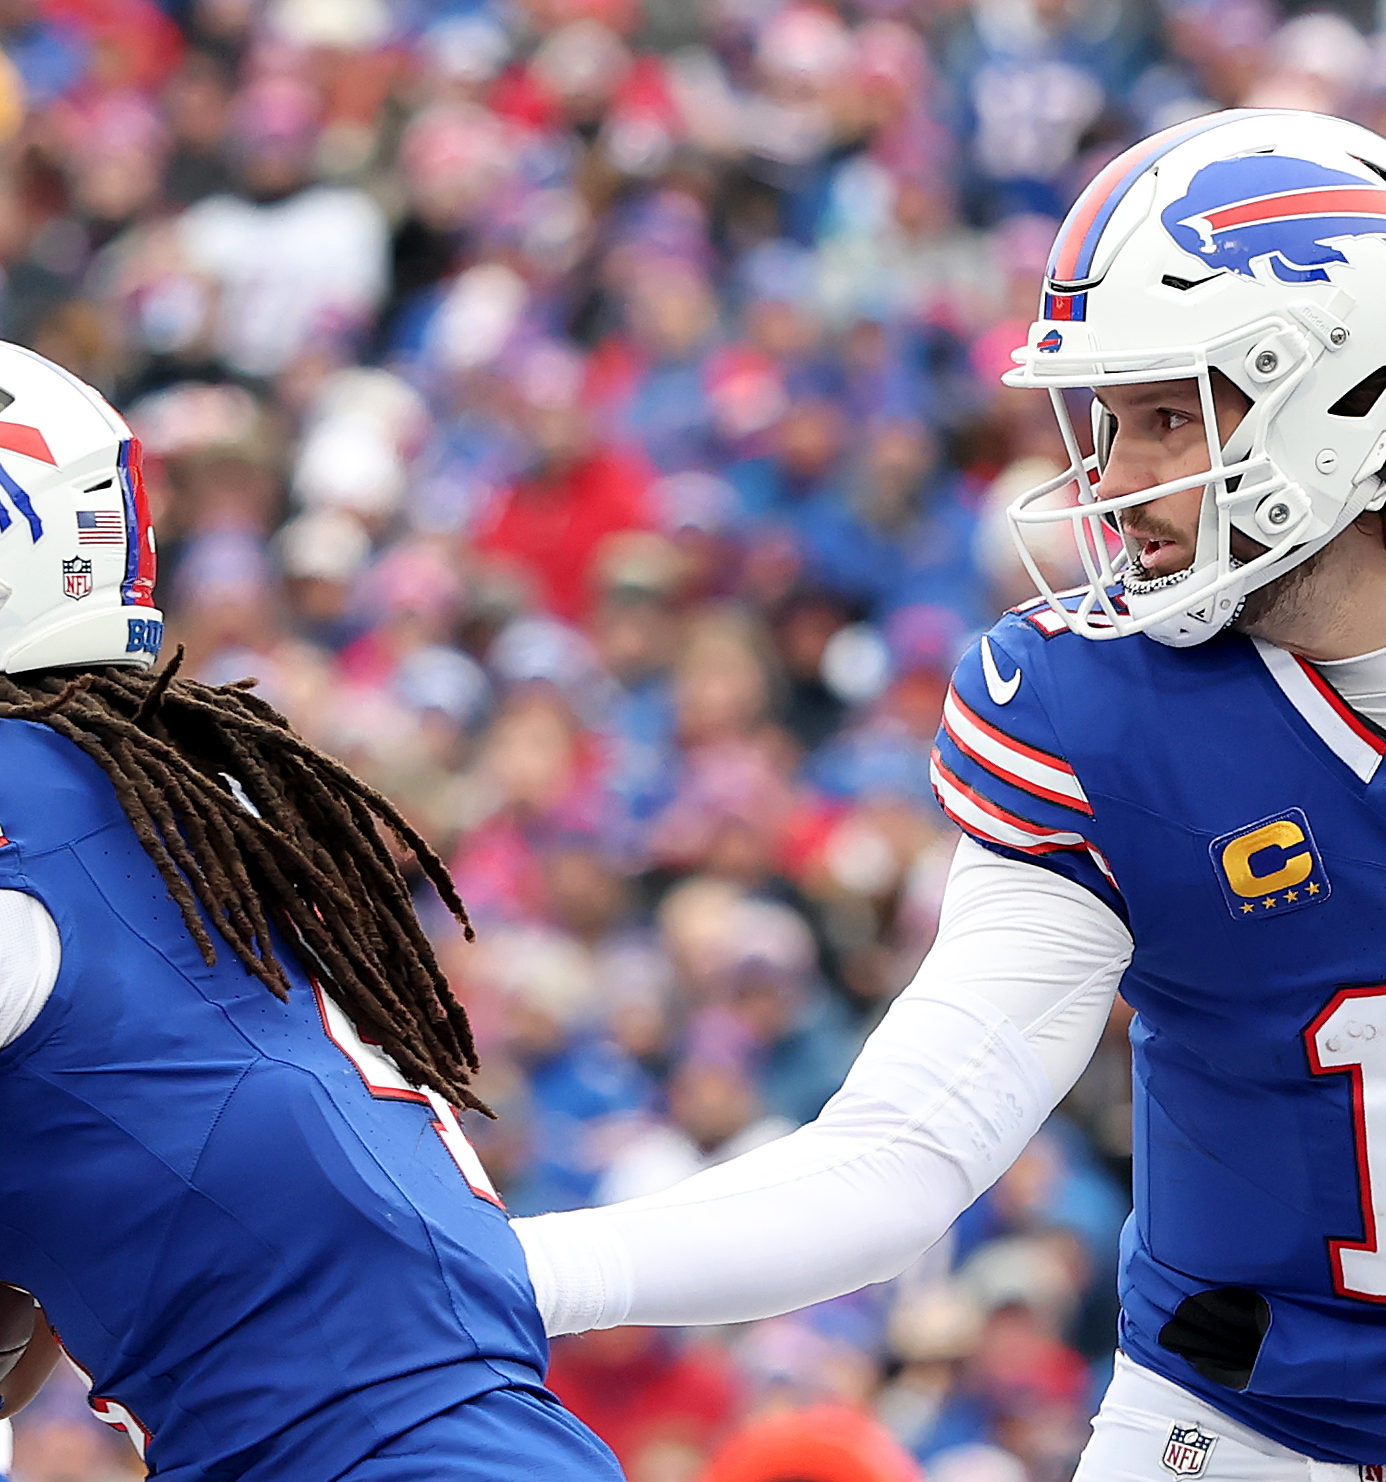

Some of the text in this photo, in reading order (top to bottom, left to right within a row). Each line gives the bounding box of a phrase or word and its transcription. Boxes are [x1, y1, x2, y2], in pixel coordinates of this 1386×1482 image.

[64, 574, 91, 597] NFL
[1221, 819, 1314, 899] C
[1166, 1442, 1200, 1472] NFL
